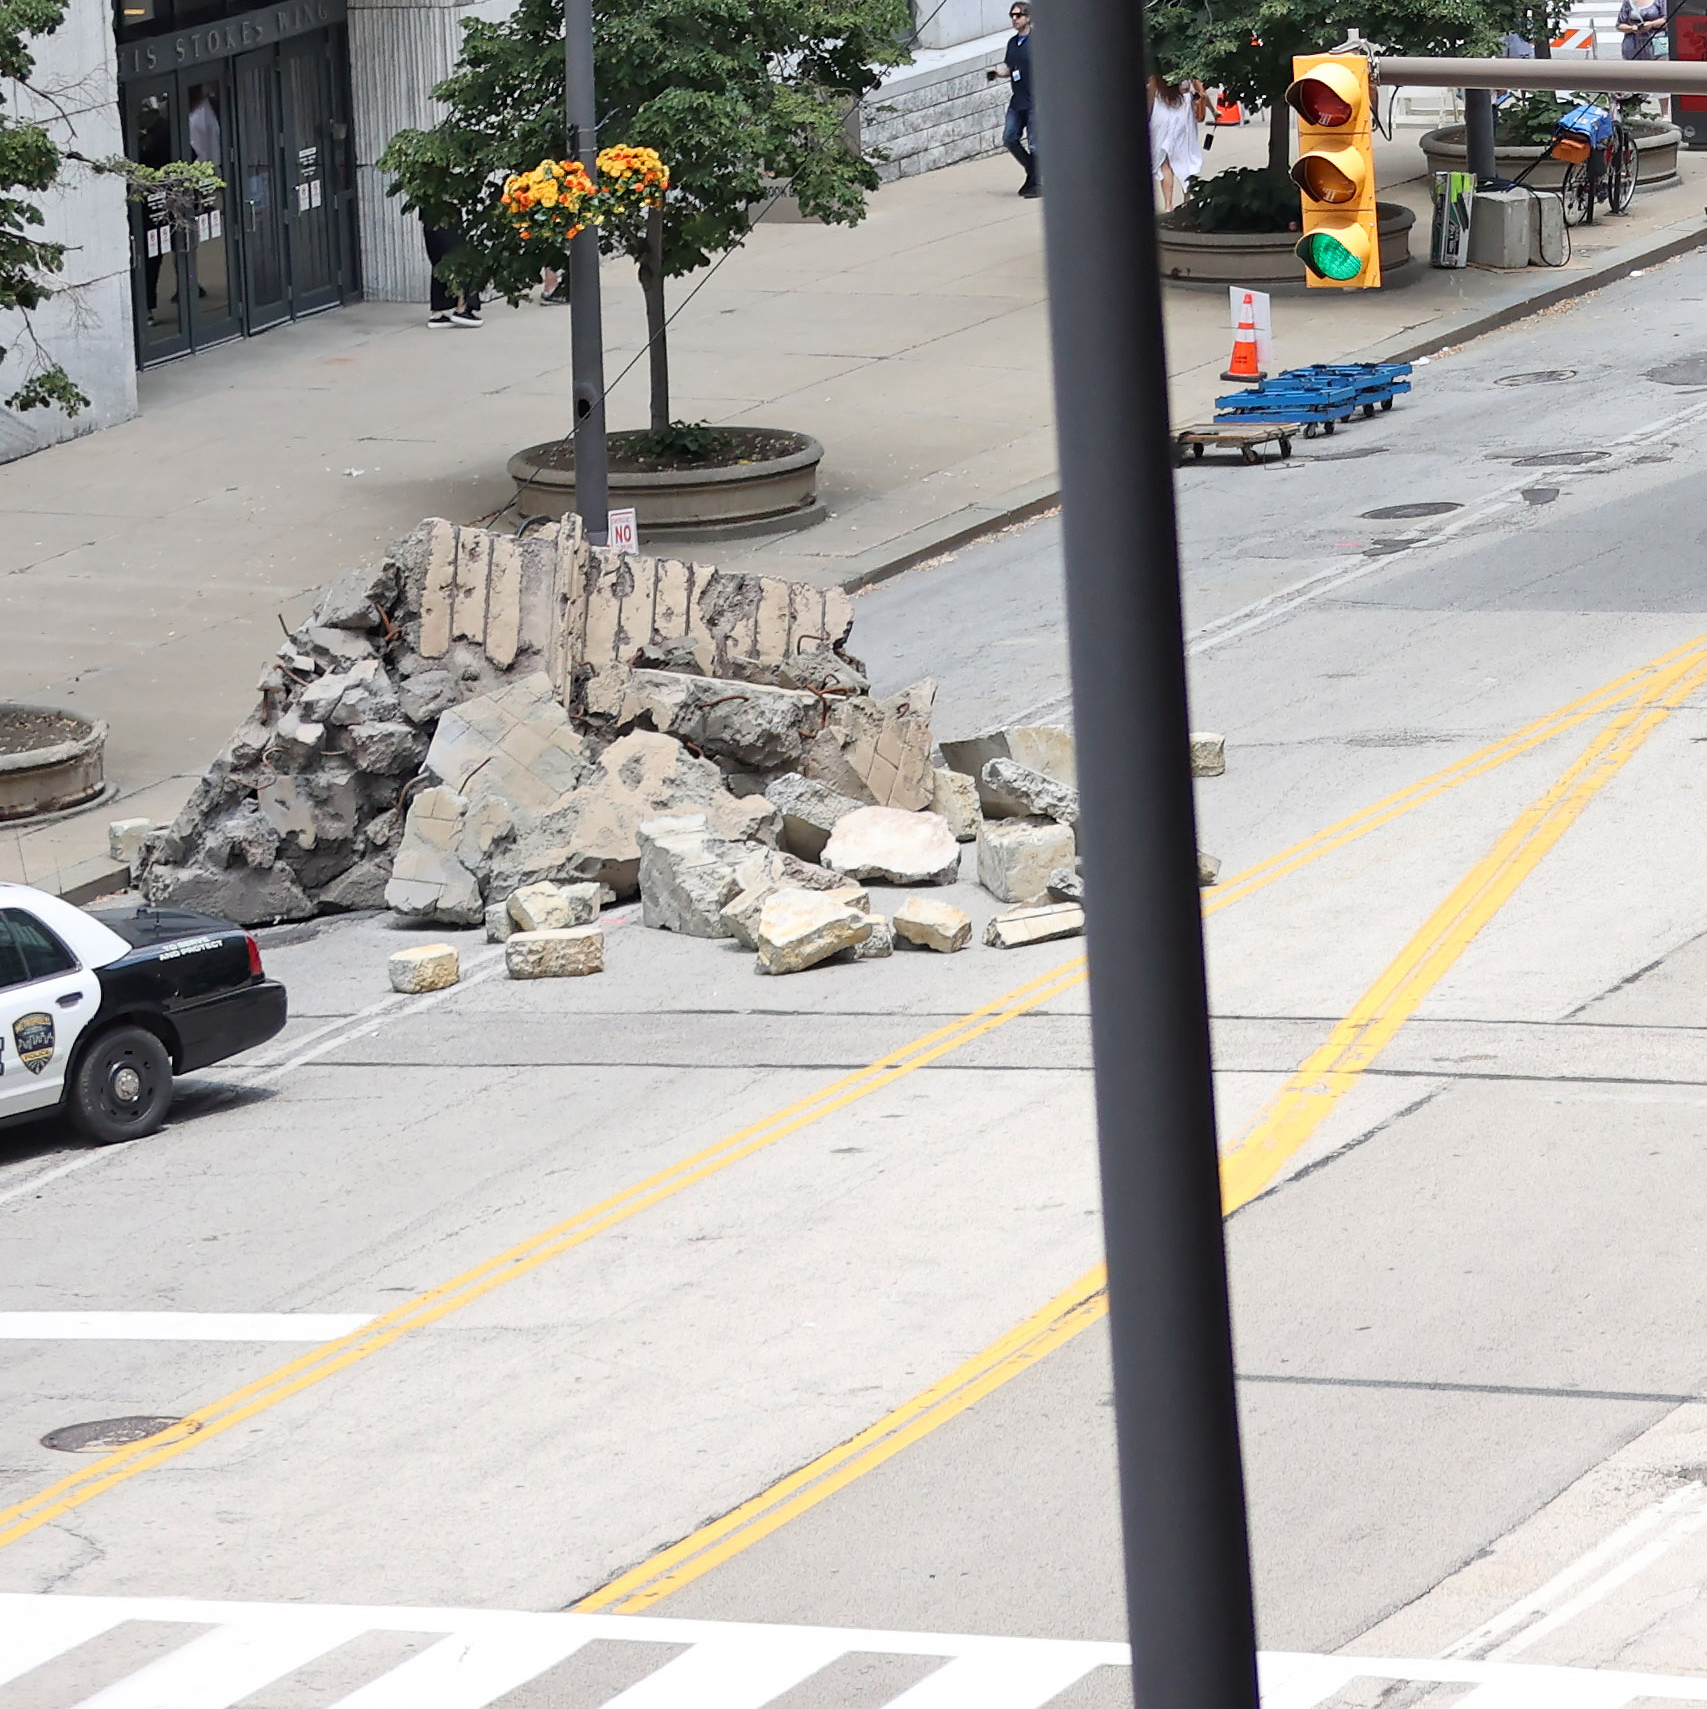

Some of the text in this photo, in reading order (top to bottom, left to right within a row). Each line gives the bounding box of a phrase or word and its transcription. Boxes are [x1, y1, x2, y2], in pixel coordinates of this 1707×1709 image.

[175, 20, 264, 62] STOKES
[277, 0, 329, 35] WING
[615, 524, 631, 544] NO
[159, 939, 223, 962] AND PROTECT
[162, 943, 176, 952] TO
